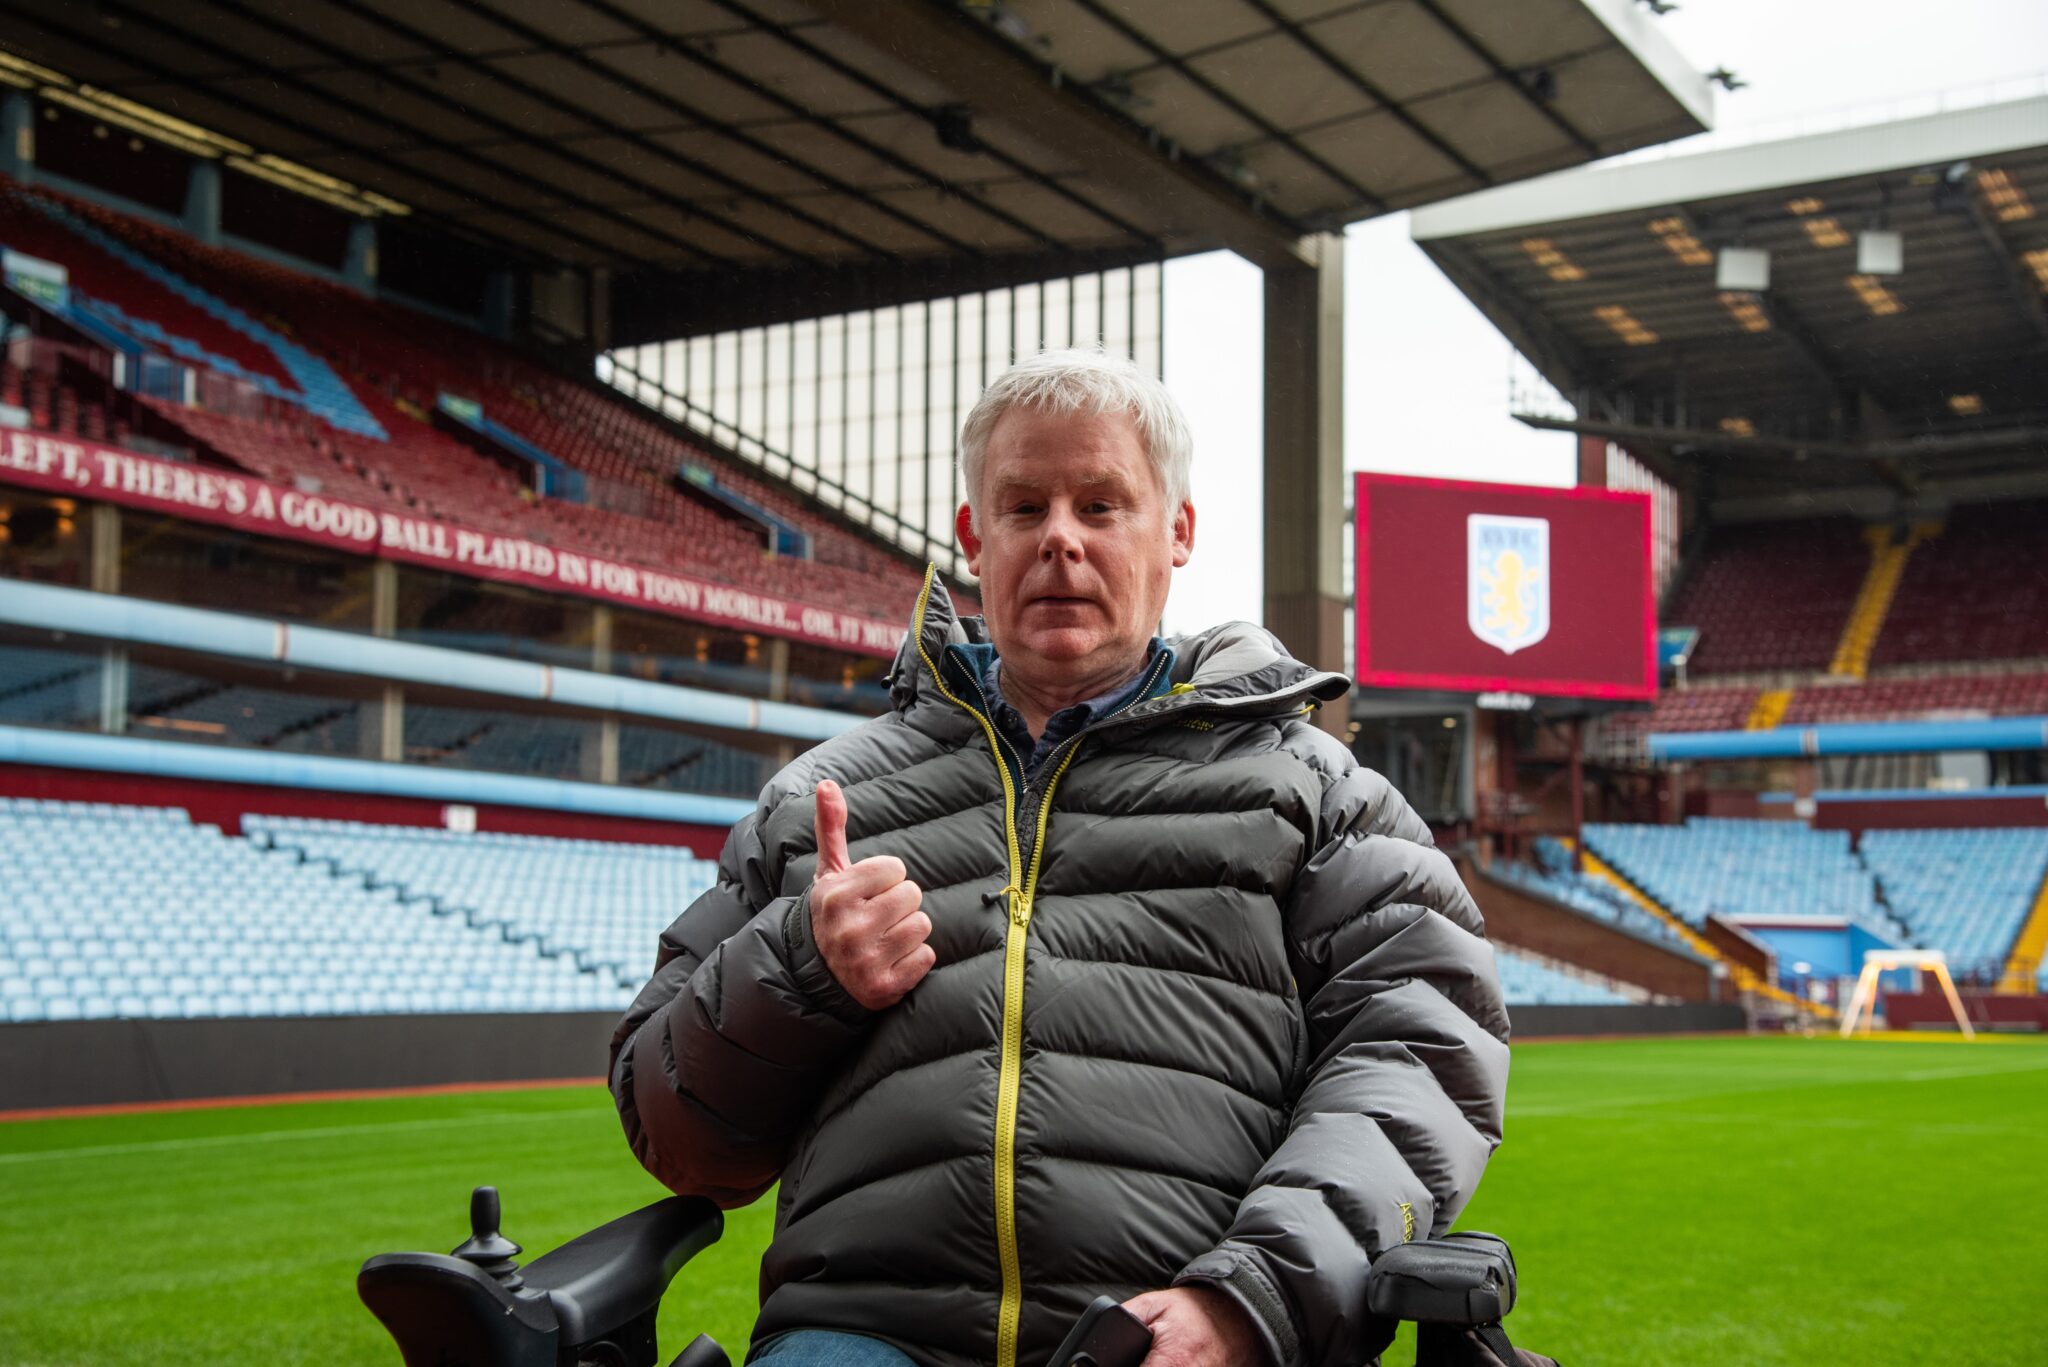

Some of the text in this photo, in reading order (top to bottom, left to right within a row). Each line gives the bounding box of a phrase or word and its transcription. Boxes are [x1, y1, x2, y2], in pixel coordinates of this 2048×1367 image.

[95, 451, 246, 515] THERE'S
[251, 483, 275, 521] A
[280, 491, 377, 542] GOOD
[380, 513, 453, 559] BALL
[456, 530, 555, 577] PLAYED
[558, 553, 588, 584] IN
[590, 560, 639, 597] FOR
[641, 569, 700, 611] TONY
